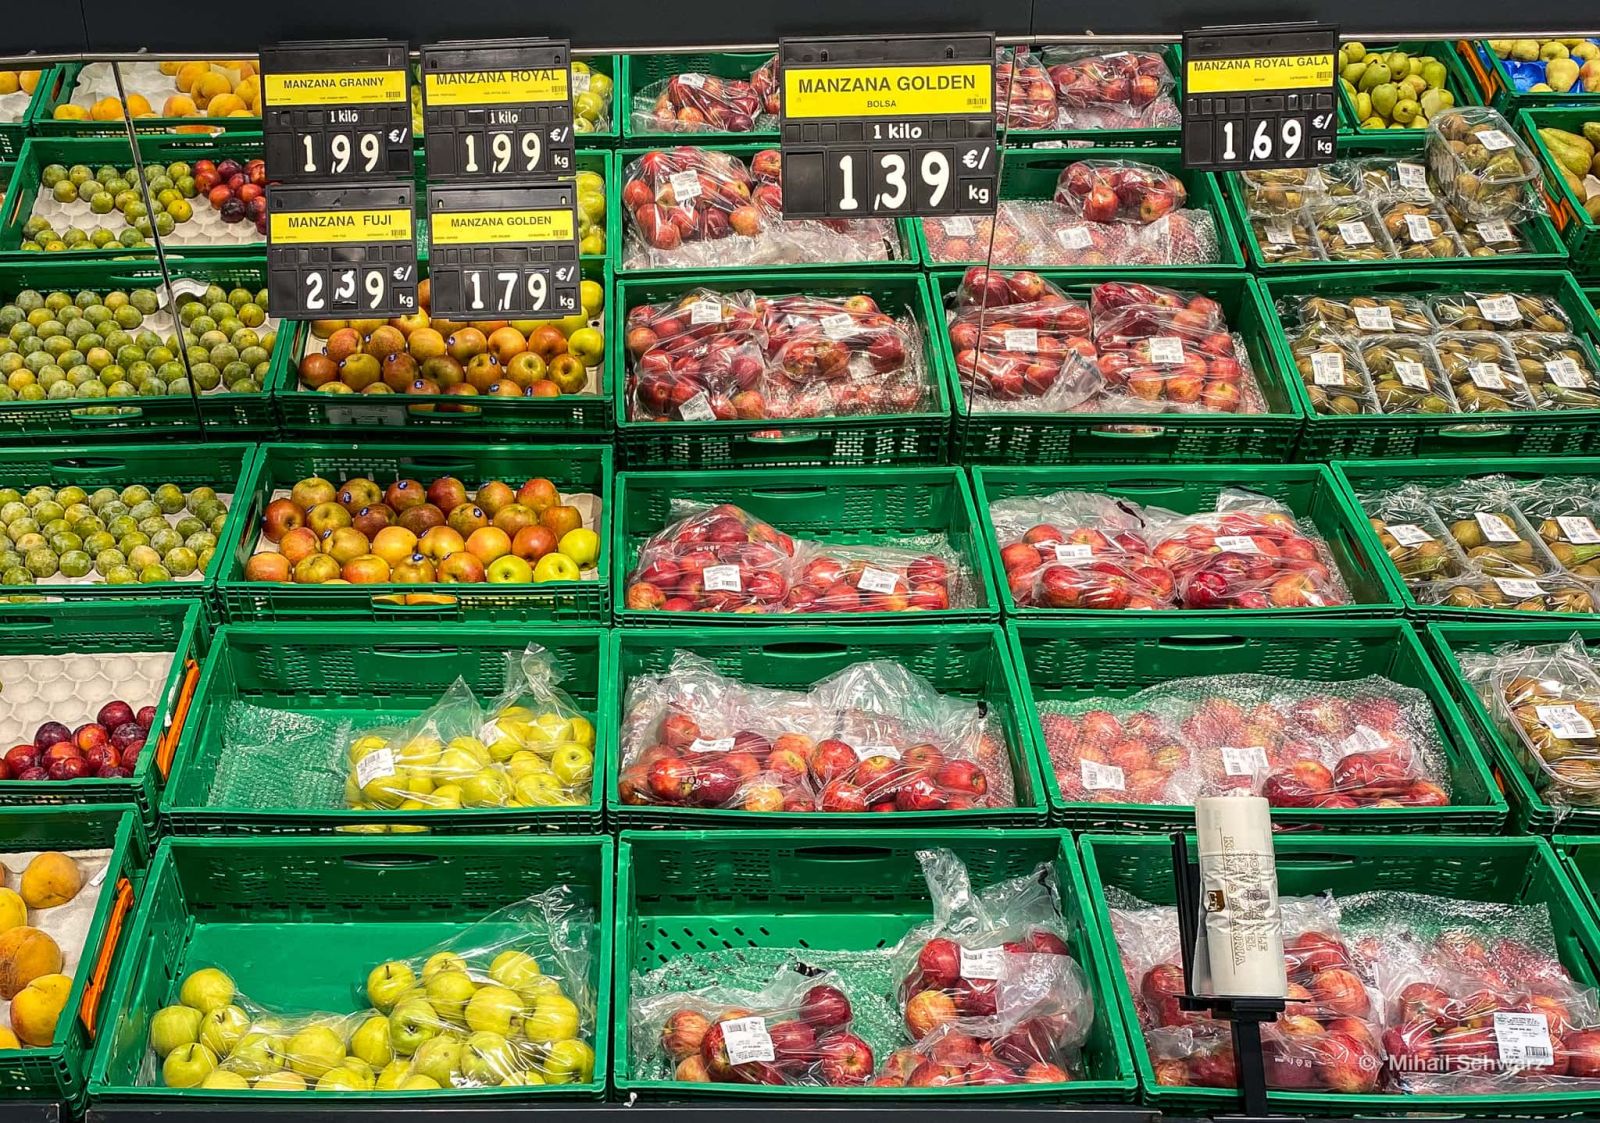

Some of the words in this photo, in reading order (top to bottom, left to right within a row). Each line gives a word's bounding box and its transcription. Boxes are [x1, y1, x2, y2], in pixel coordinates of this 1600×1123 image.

[1194, 60, 1251, 72] MANZANA
[1254, 58, 1294, 69] ROYAL
[1296, 56, 1329, 67] GALA
[284, 80, 336, 89] MANZANA
[339, 77, 385, 87] GRANNY
[436, 73, 506, 85] MANZANA
[511, 70, 559, 82] ROYAL
[798, 77, 891, 93] MANZANA
[896, 74, 975, 91] GOLDEN
[867, 99, 897, 108] BOLSA
[330, 110, 336, 123] 1
[338, 110, 358, 123] kilo
[490, 111, 495, 124] 1
[498, 111, 518, 124] kilo
[873, 125, 881, 140] 1
[888, 123, 922, 139] kilo
[1223, 118, 1302, 161] 1,69
[1317, 139, 1332, 154] kg
[303, 133, 379, 174] 1,99
[465, 132, 541, 173] 1,99
[554, 154, 568, 168] kg
[838, 150, 950, 211] 1,39
[968, 185, 989, 204] kg
[288, 217, 355, 228] MANZANA
[363, 215, 392, 226] FUJI
[451, 218, 503, 227] MANZANA
[506, 216, 552, 226] GOLDEN
[471, 273, 547, 311] 1,79
[399, 294, 414, 308] kg
[559, 295, 575, 310] kg
